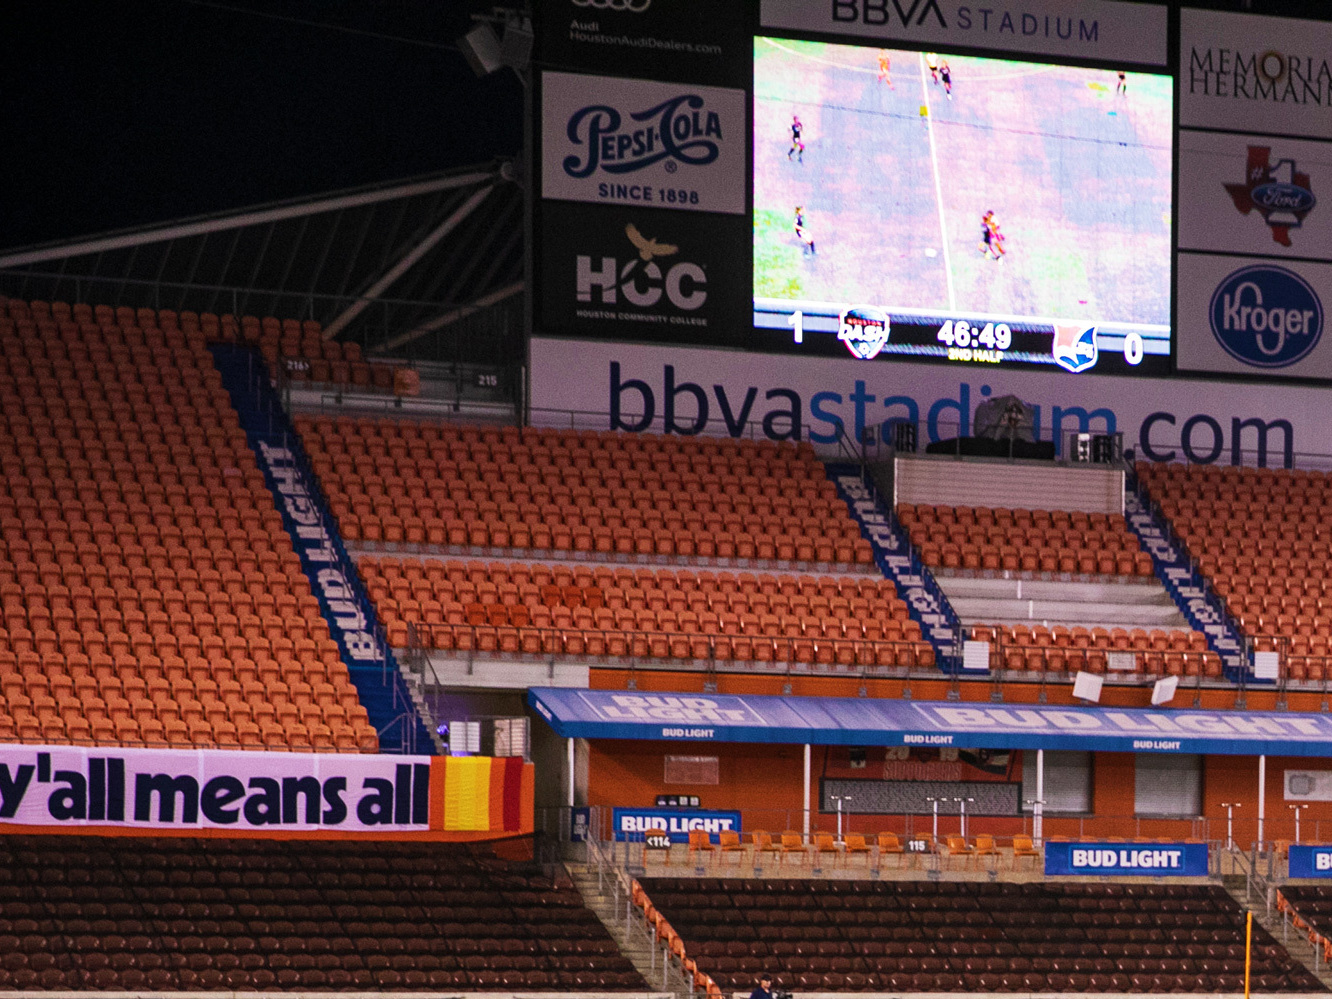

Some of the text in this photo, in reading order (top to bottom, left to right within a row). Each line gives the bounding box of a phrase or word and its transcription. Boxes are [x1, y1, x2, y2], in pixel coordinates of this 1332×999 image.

[570, 20, 599, 31] Audi
[832, 0, 1100, 42] BBVA STADIUM
[569, 31, 721, 54] HoustonAudiDealers.com
[598, 182, 700, 205] SINCE 1898
[576, 255, 708, 310] HCC
[577, 310, 708, 326] HOUSTON COMMUNITY COLLEGE
[787, 310, 804, 343] 1
[1223, 281, 1314, 356] Kroger
[837, 323, 891, 342] DASH
[937, 320, 1012, 350] 46:49
[948, 347, 1004, 364] 2ND HALF
[1123, 332, 1144, 365] 0
[479, 374, 498, 386] 215
[609, 360, 1294, 470] bbvastadm.com
[611, 695, 719, 709] BUD
[602, 705, 746, 721] LIGHT
[933, 706, 1324, 736] BUD LIGHT
[662, 728, 715, 738] BUD LIGHT
[903, 735, 953, 745] BUD LIGHT
[1133, 740, 1181, 750] BUD LIGHT
[0, 752, 430, 826] y'all means all
[621, 816, 733, 832] BUD LIGHT
[653, 836, 671, 847] 114
[908, 840, 926, 852] 115
[1072, 848, 1182, 869] BUD LIGHT
